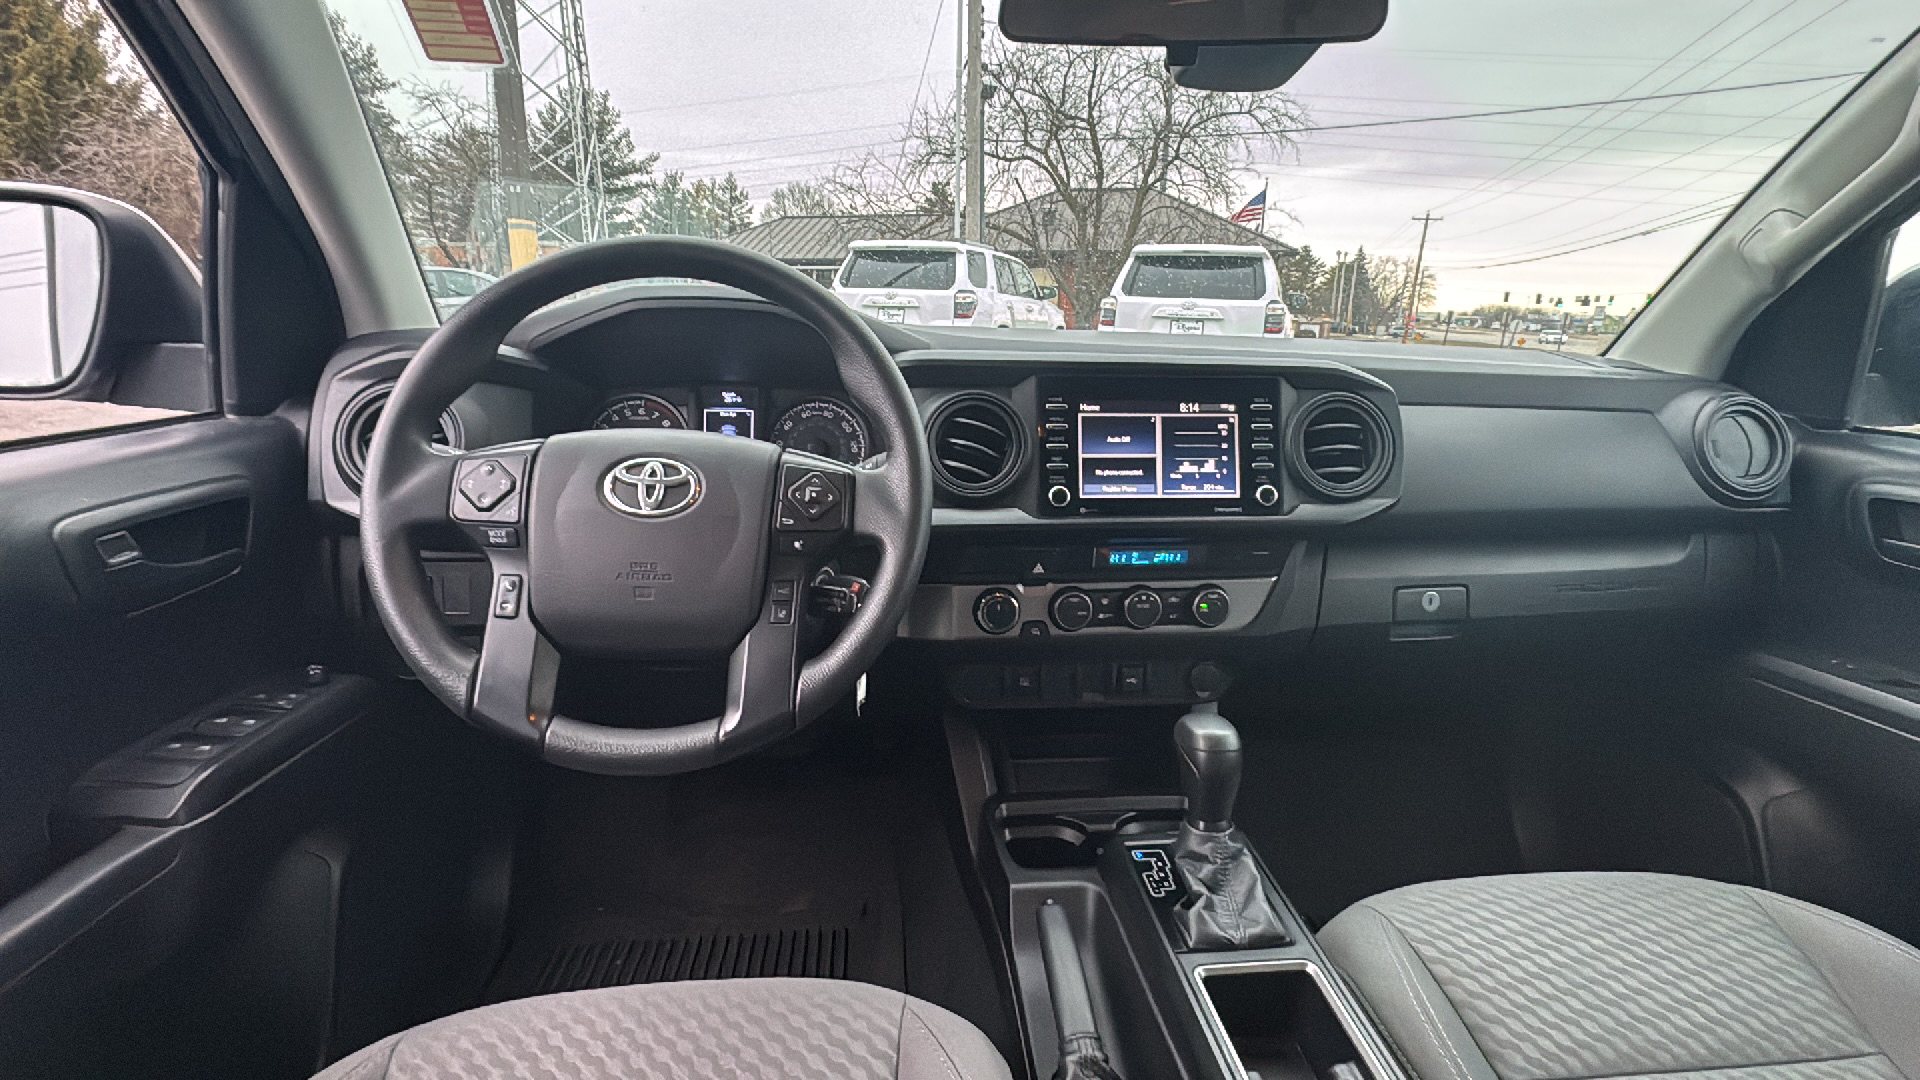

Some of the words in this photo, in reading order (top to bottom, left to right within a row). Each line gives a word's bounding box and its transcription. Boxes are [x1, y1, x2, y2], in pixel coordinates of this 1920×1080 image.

[1080, 403, 1101, 412] Home
[1180, 402, 1200, 413] 8:14
[801, 409, 812, 419] 60
[823, 409, 834, 419] 80
[615, 572, 673, 581] AIRBAG
